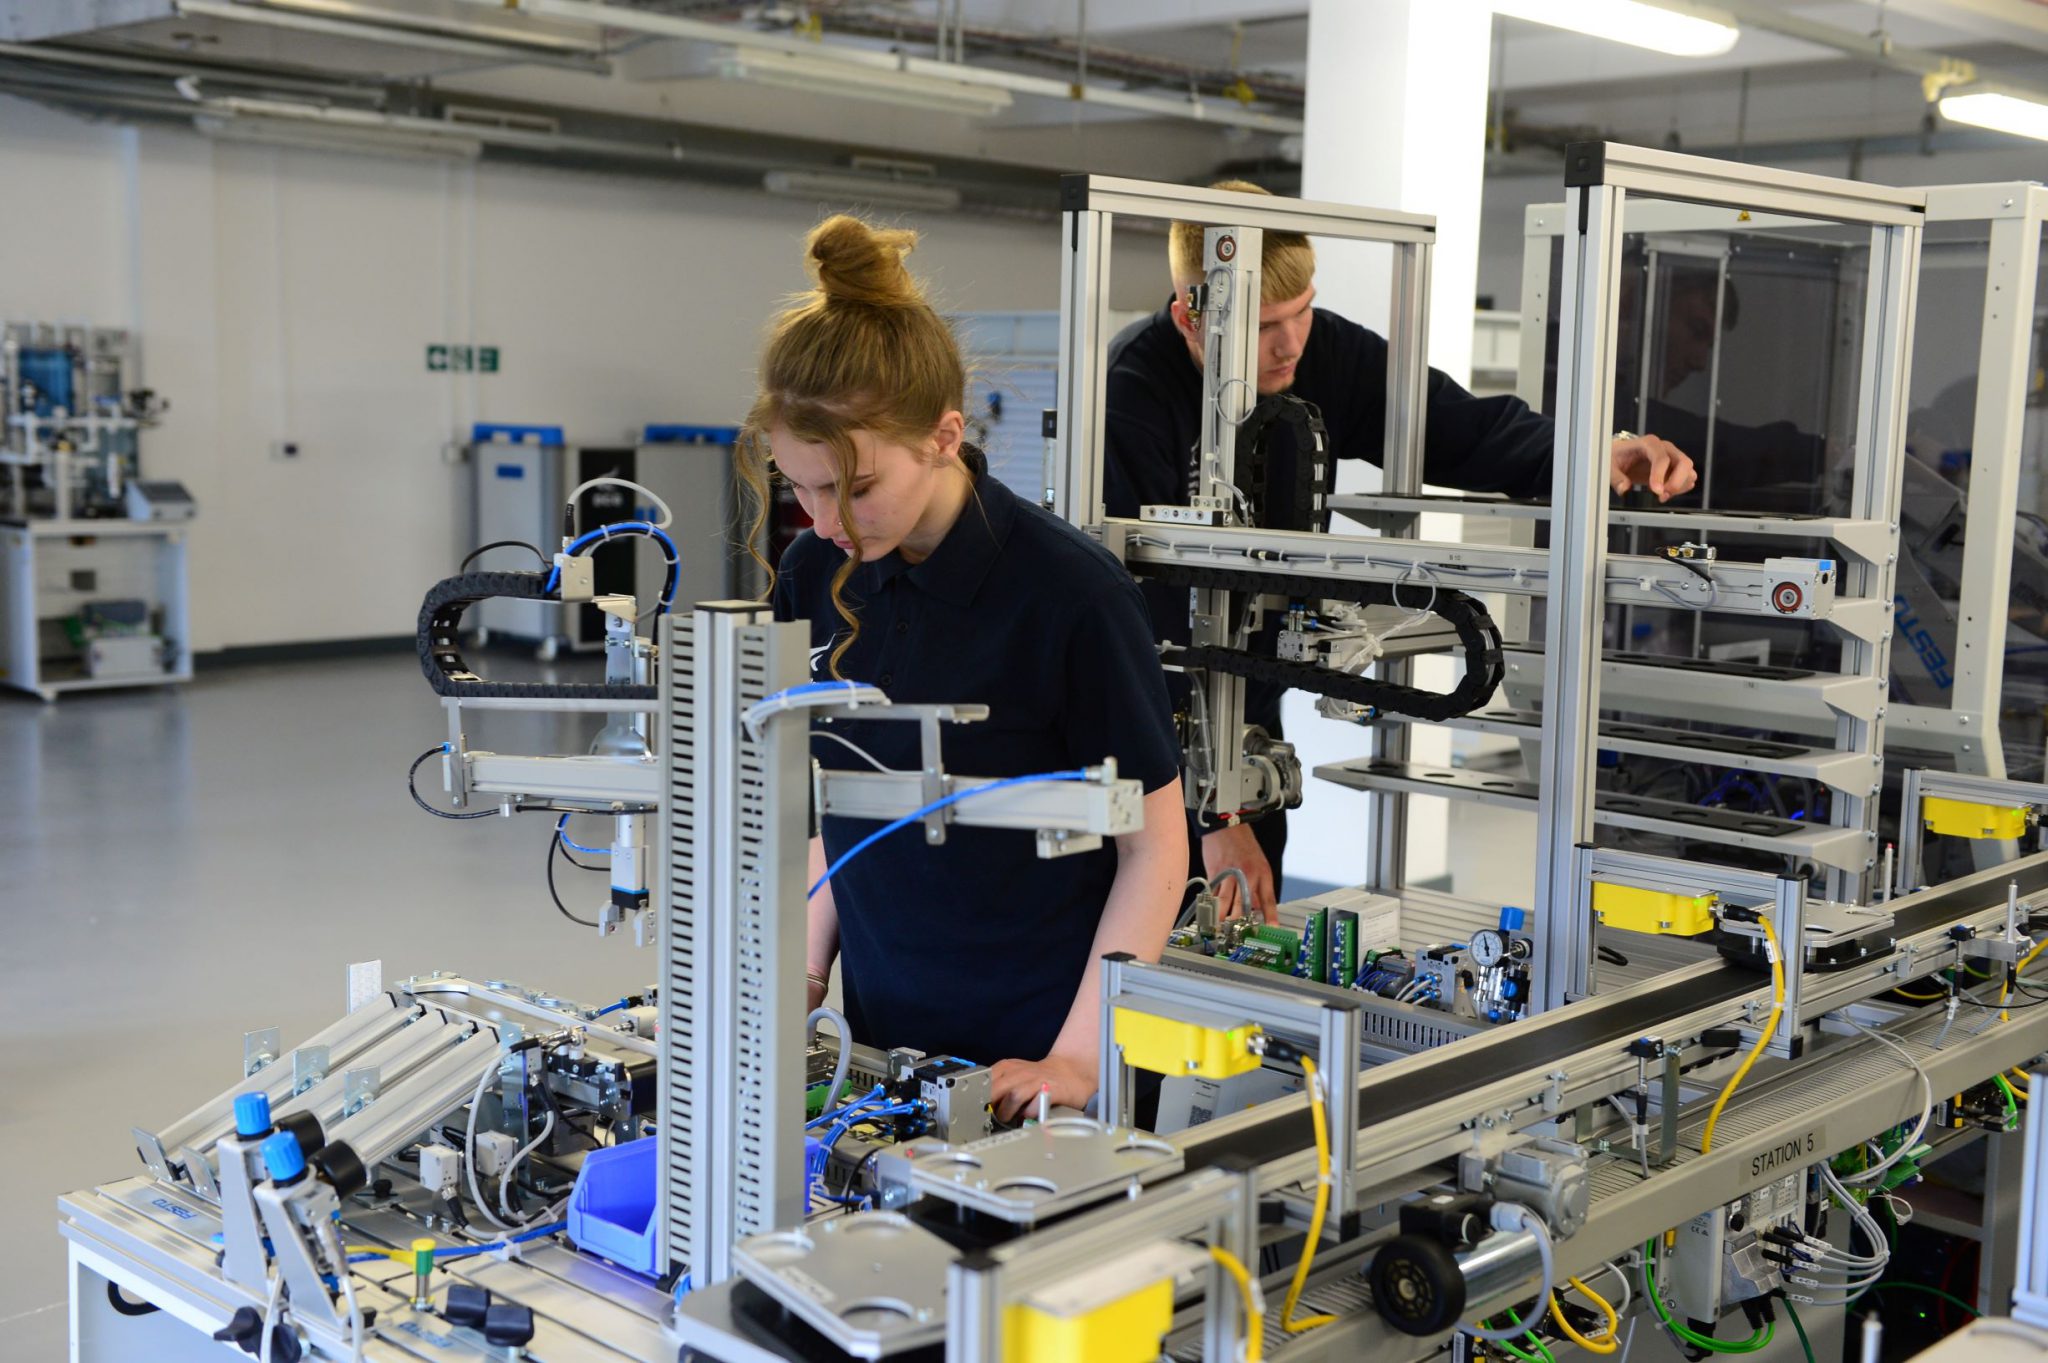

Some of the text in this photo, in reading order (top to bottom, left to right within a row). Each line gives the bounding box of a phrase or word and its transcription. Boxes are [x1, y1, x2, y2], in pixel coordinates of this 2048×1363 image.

[1894, 594, 1953, 689] FESTO
[1752, 1133, 1814, 1176] STATION 5
[152, 1199, 198, 1219] FESTO
